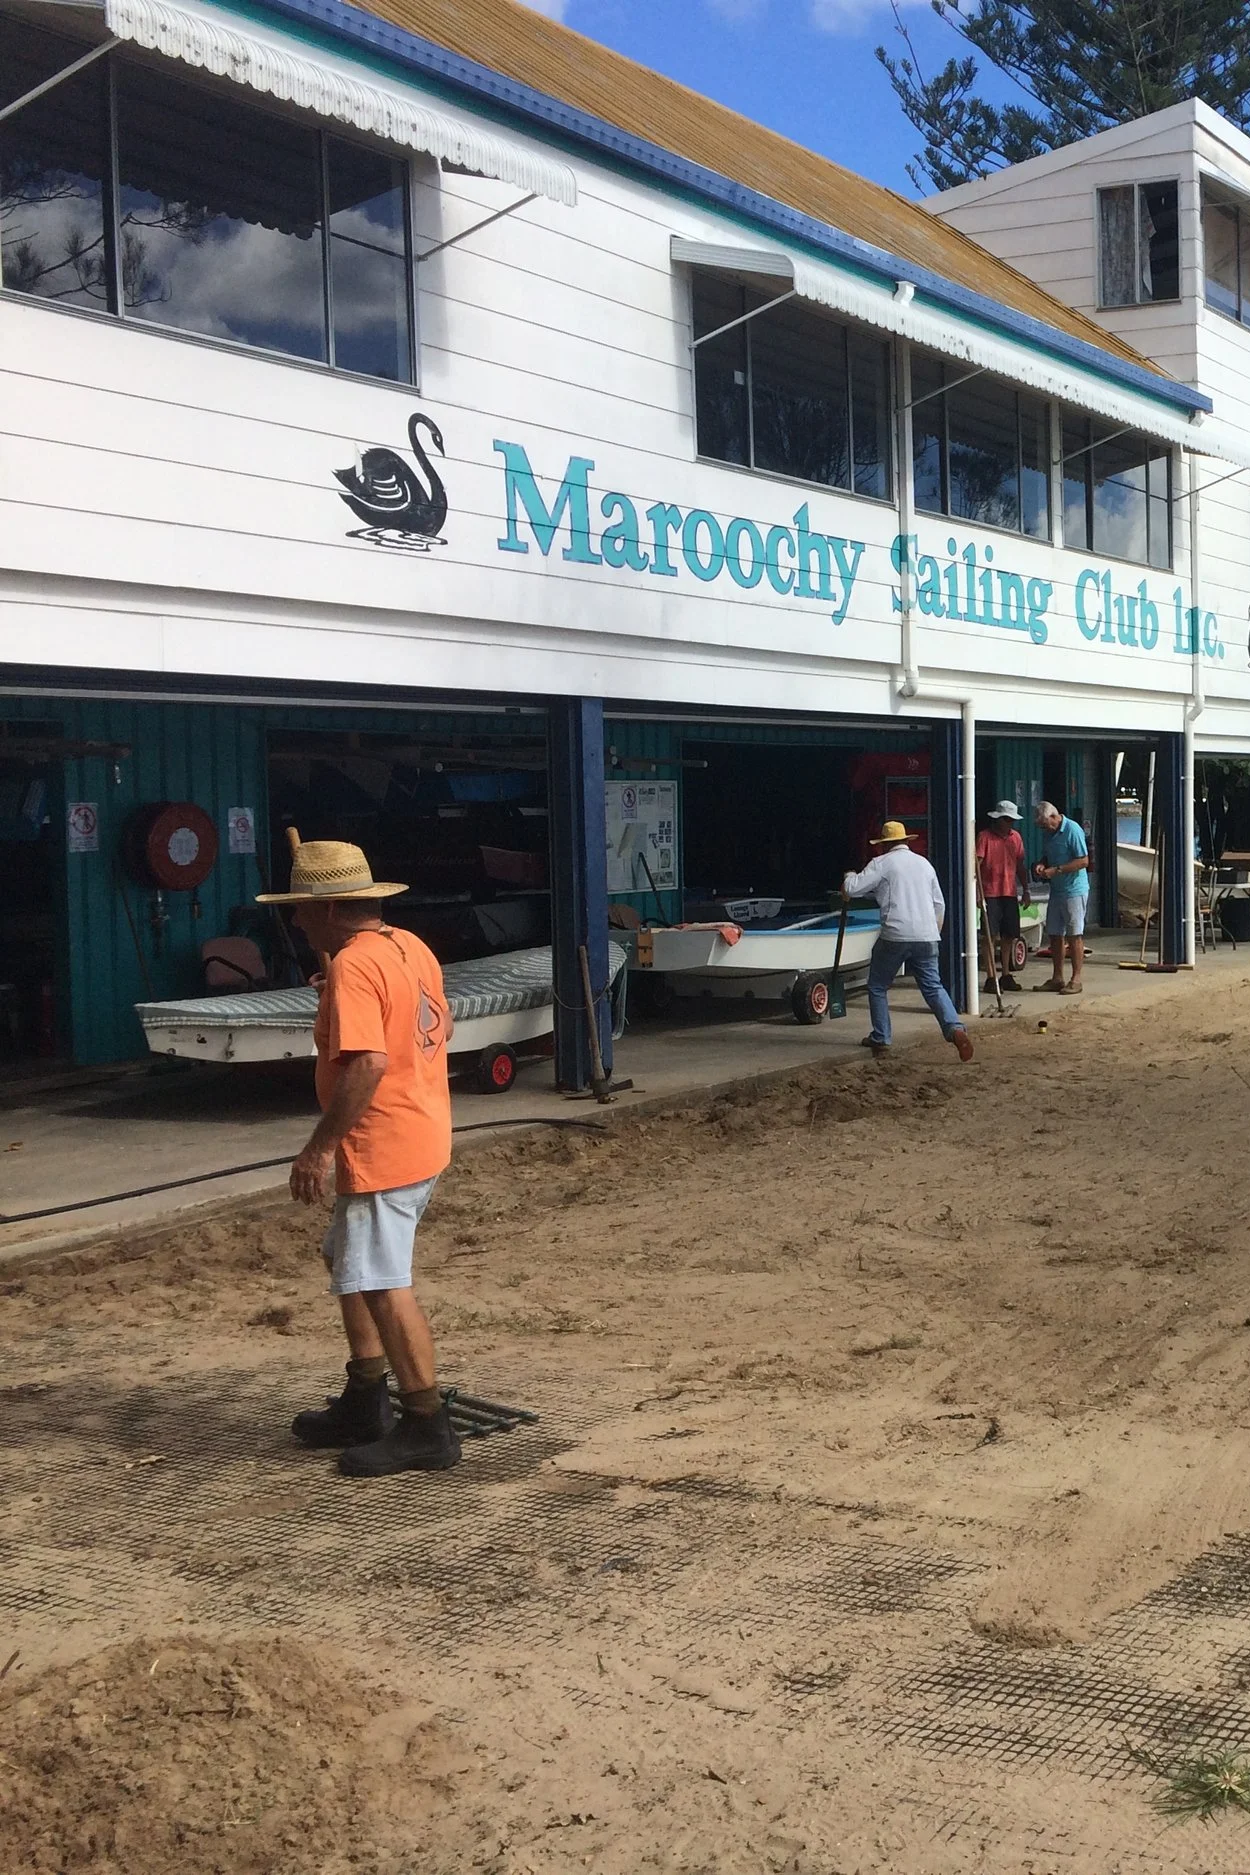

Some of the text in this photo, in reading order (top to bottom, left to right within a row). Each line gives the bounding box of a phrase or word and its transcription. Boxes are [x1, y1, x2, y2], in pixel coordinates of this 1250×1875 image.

[492, 438, 1225, 660] Maroochy Sailing Club Inc.
